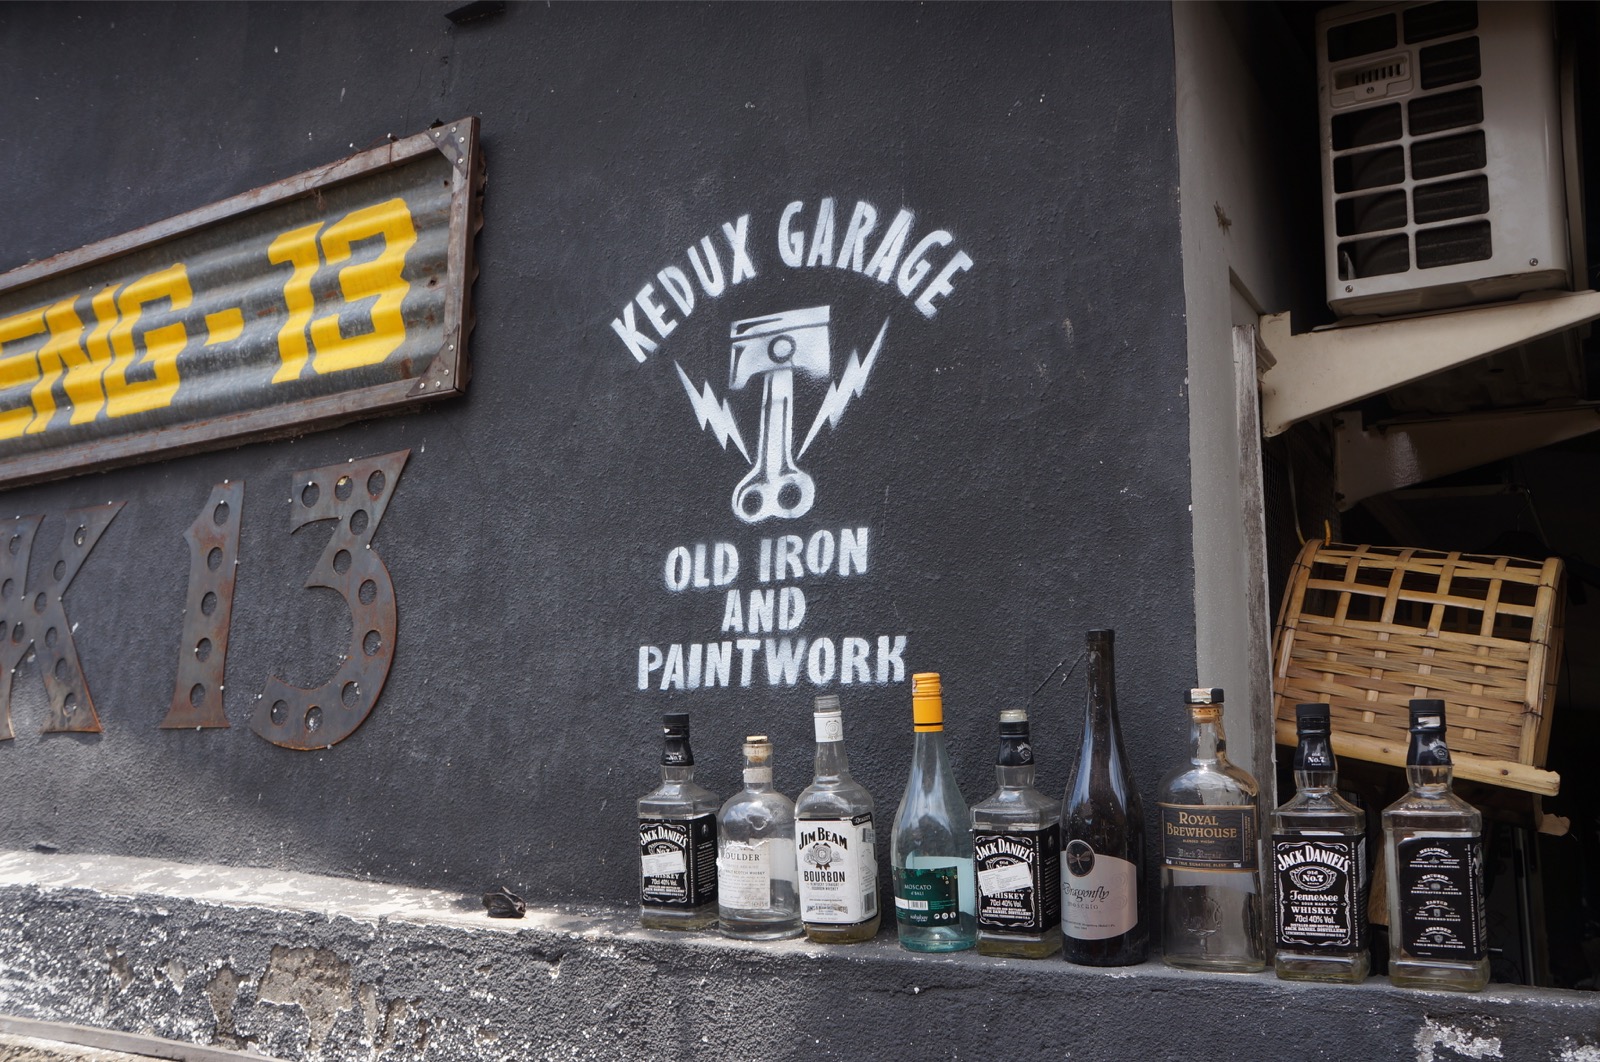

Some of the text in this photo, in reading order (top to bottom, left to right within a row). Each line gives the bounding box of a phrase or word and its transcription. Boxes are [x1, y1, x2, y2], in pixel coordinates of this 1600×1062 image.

[610, 197, 974, 363] KEDUX GARAGE
[664, 526, 869, 592] OLD IRON
[160, 448, 411, 751] 13
[721, 586, 807, 634] AND
[637, 635, 907, 691] PAINTWORK
[1178, 812, 1218, 826] ROYAL
[640, 829, 659, 846] JACK
[799, 827, 848, 850] JIM BEAM
[1166, 822, 1237, 838] BREWHOUSE
[723, 852, 760, 861] OULDER
[976, 838, 1036, 863] JACK DANIEL'S
[1277, 845, 1351, 872] JACK DANIEL'S
[804, 871, 846, 882] BOURBON
[1062, 882, 1110, 902] Dragonfly
[1290, 890, 1338, 902] Tennessee
[1291, 906, 1338, 914] WHISKEY
